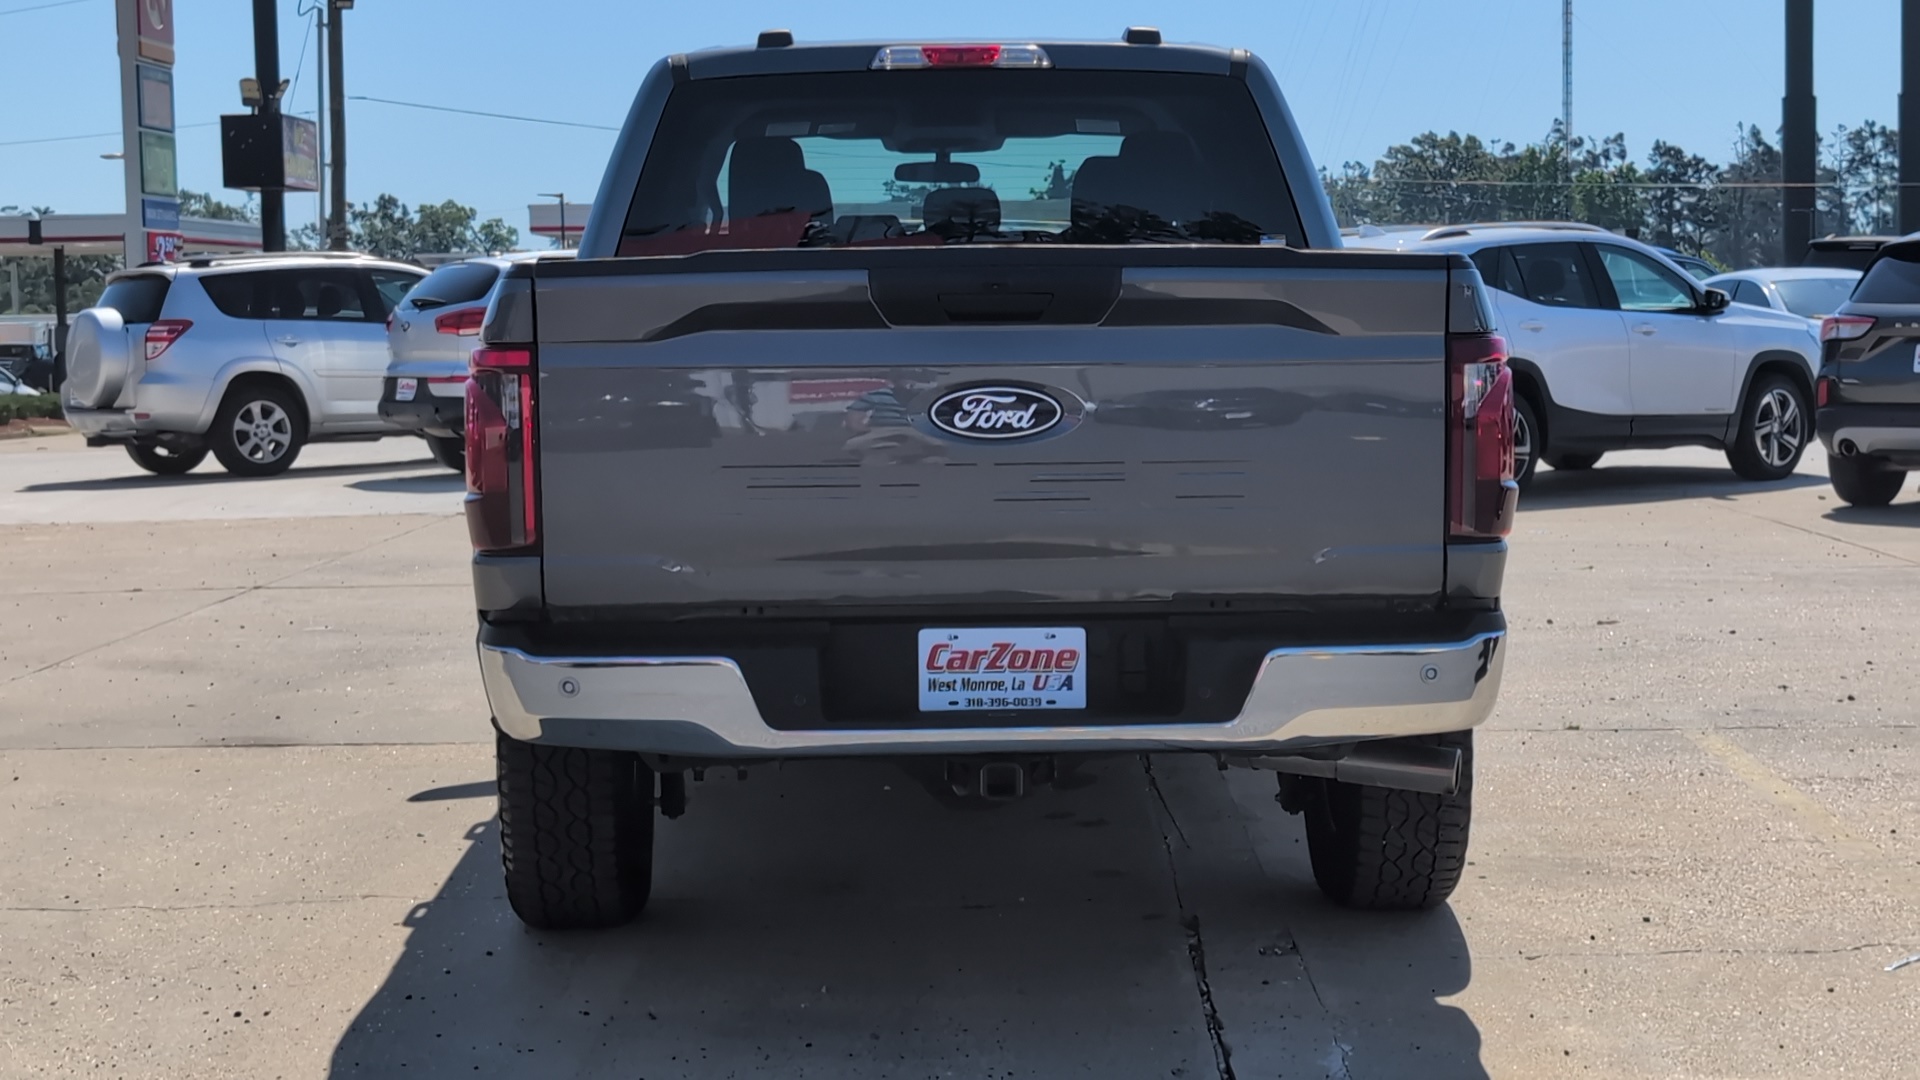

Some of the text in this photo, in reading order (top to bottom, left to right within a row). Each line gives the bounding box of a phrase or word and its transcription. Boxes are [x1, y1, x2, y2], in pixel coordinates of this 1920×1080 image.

[953, 394, 1038, 429] Ford
[926, 643, 1079, 673] CarZone
[927, 677, 1025, 693] West Monroe, La
[1032, 675, 1074, 691] USA
